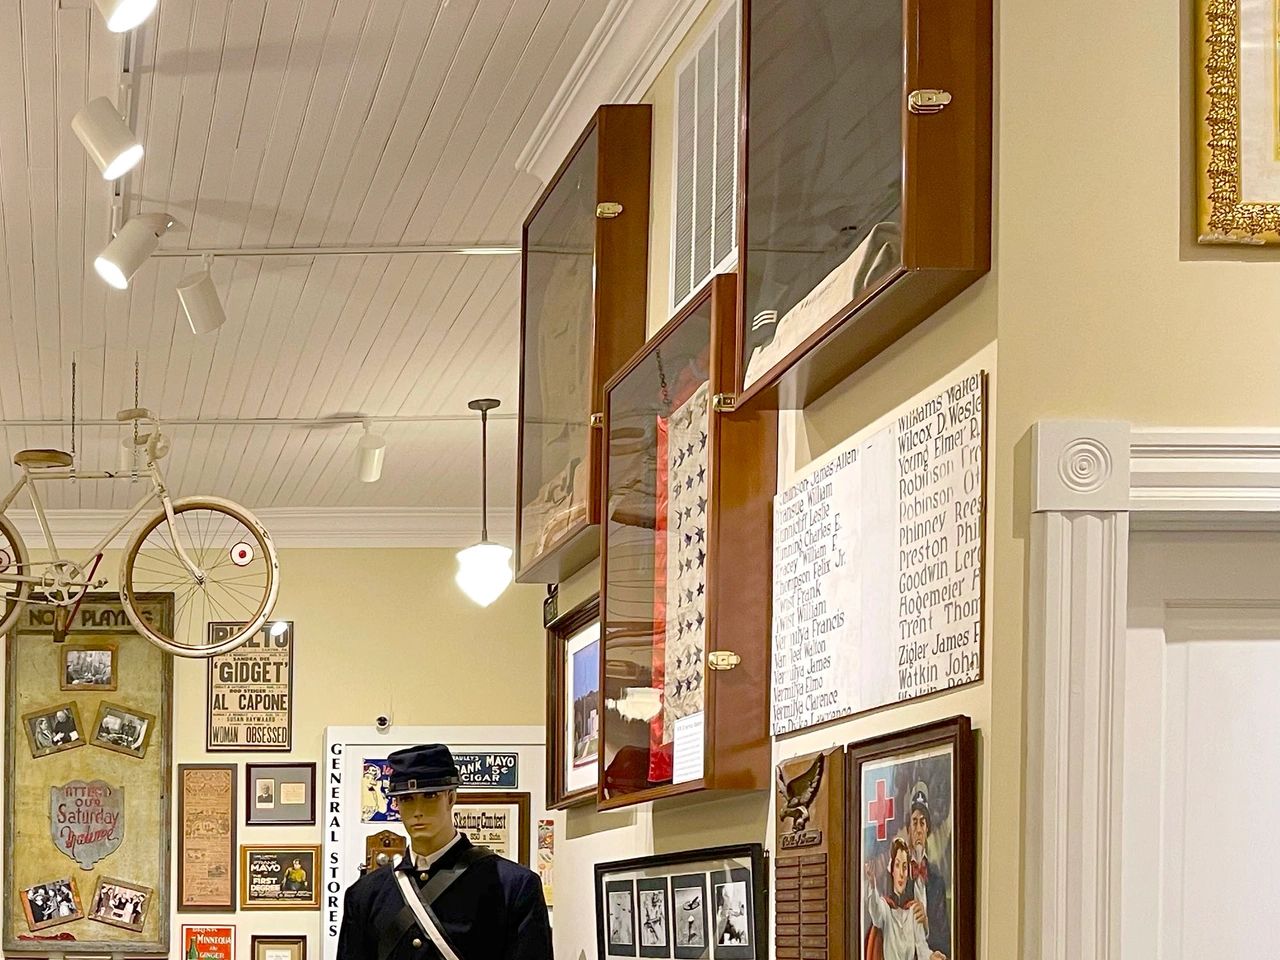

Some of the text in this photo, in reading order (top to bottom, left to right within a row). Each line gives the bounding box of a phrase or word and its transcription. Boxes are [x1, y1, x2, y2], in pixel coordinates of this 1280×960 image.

[898, 422, 932, 456] Wilcox
[937, 412, 948, 436] D.
[835, 448, 857, 472] Allen
[898, 444, 929, 477] Young
[934, 425, 967, 459] Elmer
[899, 460, 954, 500] Robinson
[899, 486, 954, 523] Robinson
[804, 522, 831, 548] Charles
[899, 510, 947, 547] Phinney
[899, 536, 948, 572] Preston
[813, 558, 831, 579] Felix
[899, 557, 948, 594] Goodwin
[797, 579, 821, 606] Frank
[899, 577, 965, 618] Hogemeier
[797, 600, 827, 625] William
[812, 608, 845, 638] Francis
[899, 610, 933, 640] Trent
[898, 641, 929, 670] Zigler
[932, 630, 970, 656] James
[807, 655, 831, 674] James
[898, 660, 938, 690] Watkin
[945, 651, 980, 677] John
[213, 693, 288, 711] AL CAPONE
[774, 676, 823, 703] Vermilya Elmo
[773, 690, 838, 721] Vermilya Clarence
[212, 726, 287, 743] WOMAN OBSESSED
[486, 755, 514, 767] MAYO
[492, 766, 509, 775] 5¢
[58, 803, 119, 828] Saturday
[75, 798, 101, 807] OUR
[453, 812, 506, 832] Skating Contest
[327, 743, 342, 937] GENERAL STORES
[251, 864, 280, 872] MAYO
